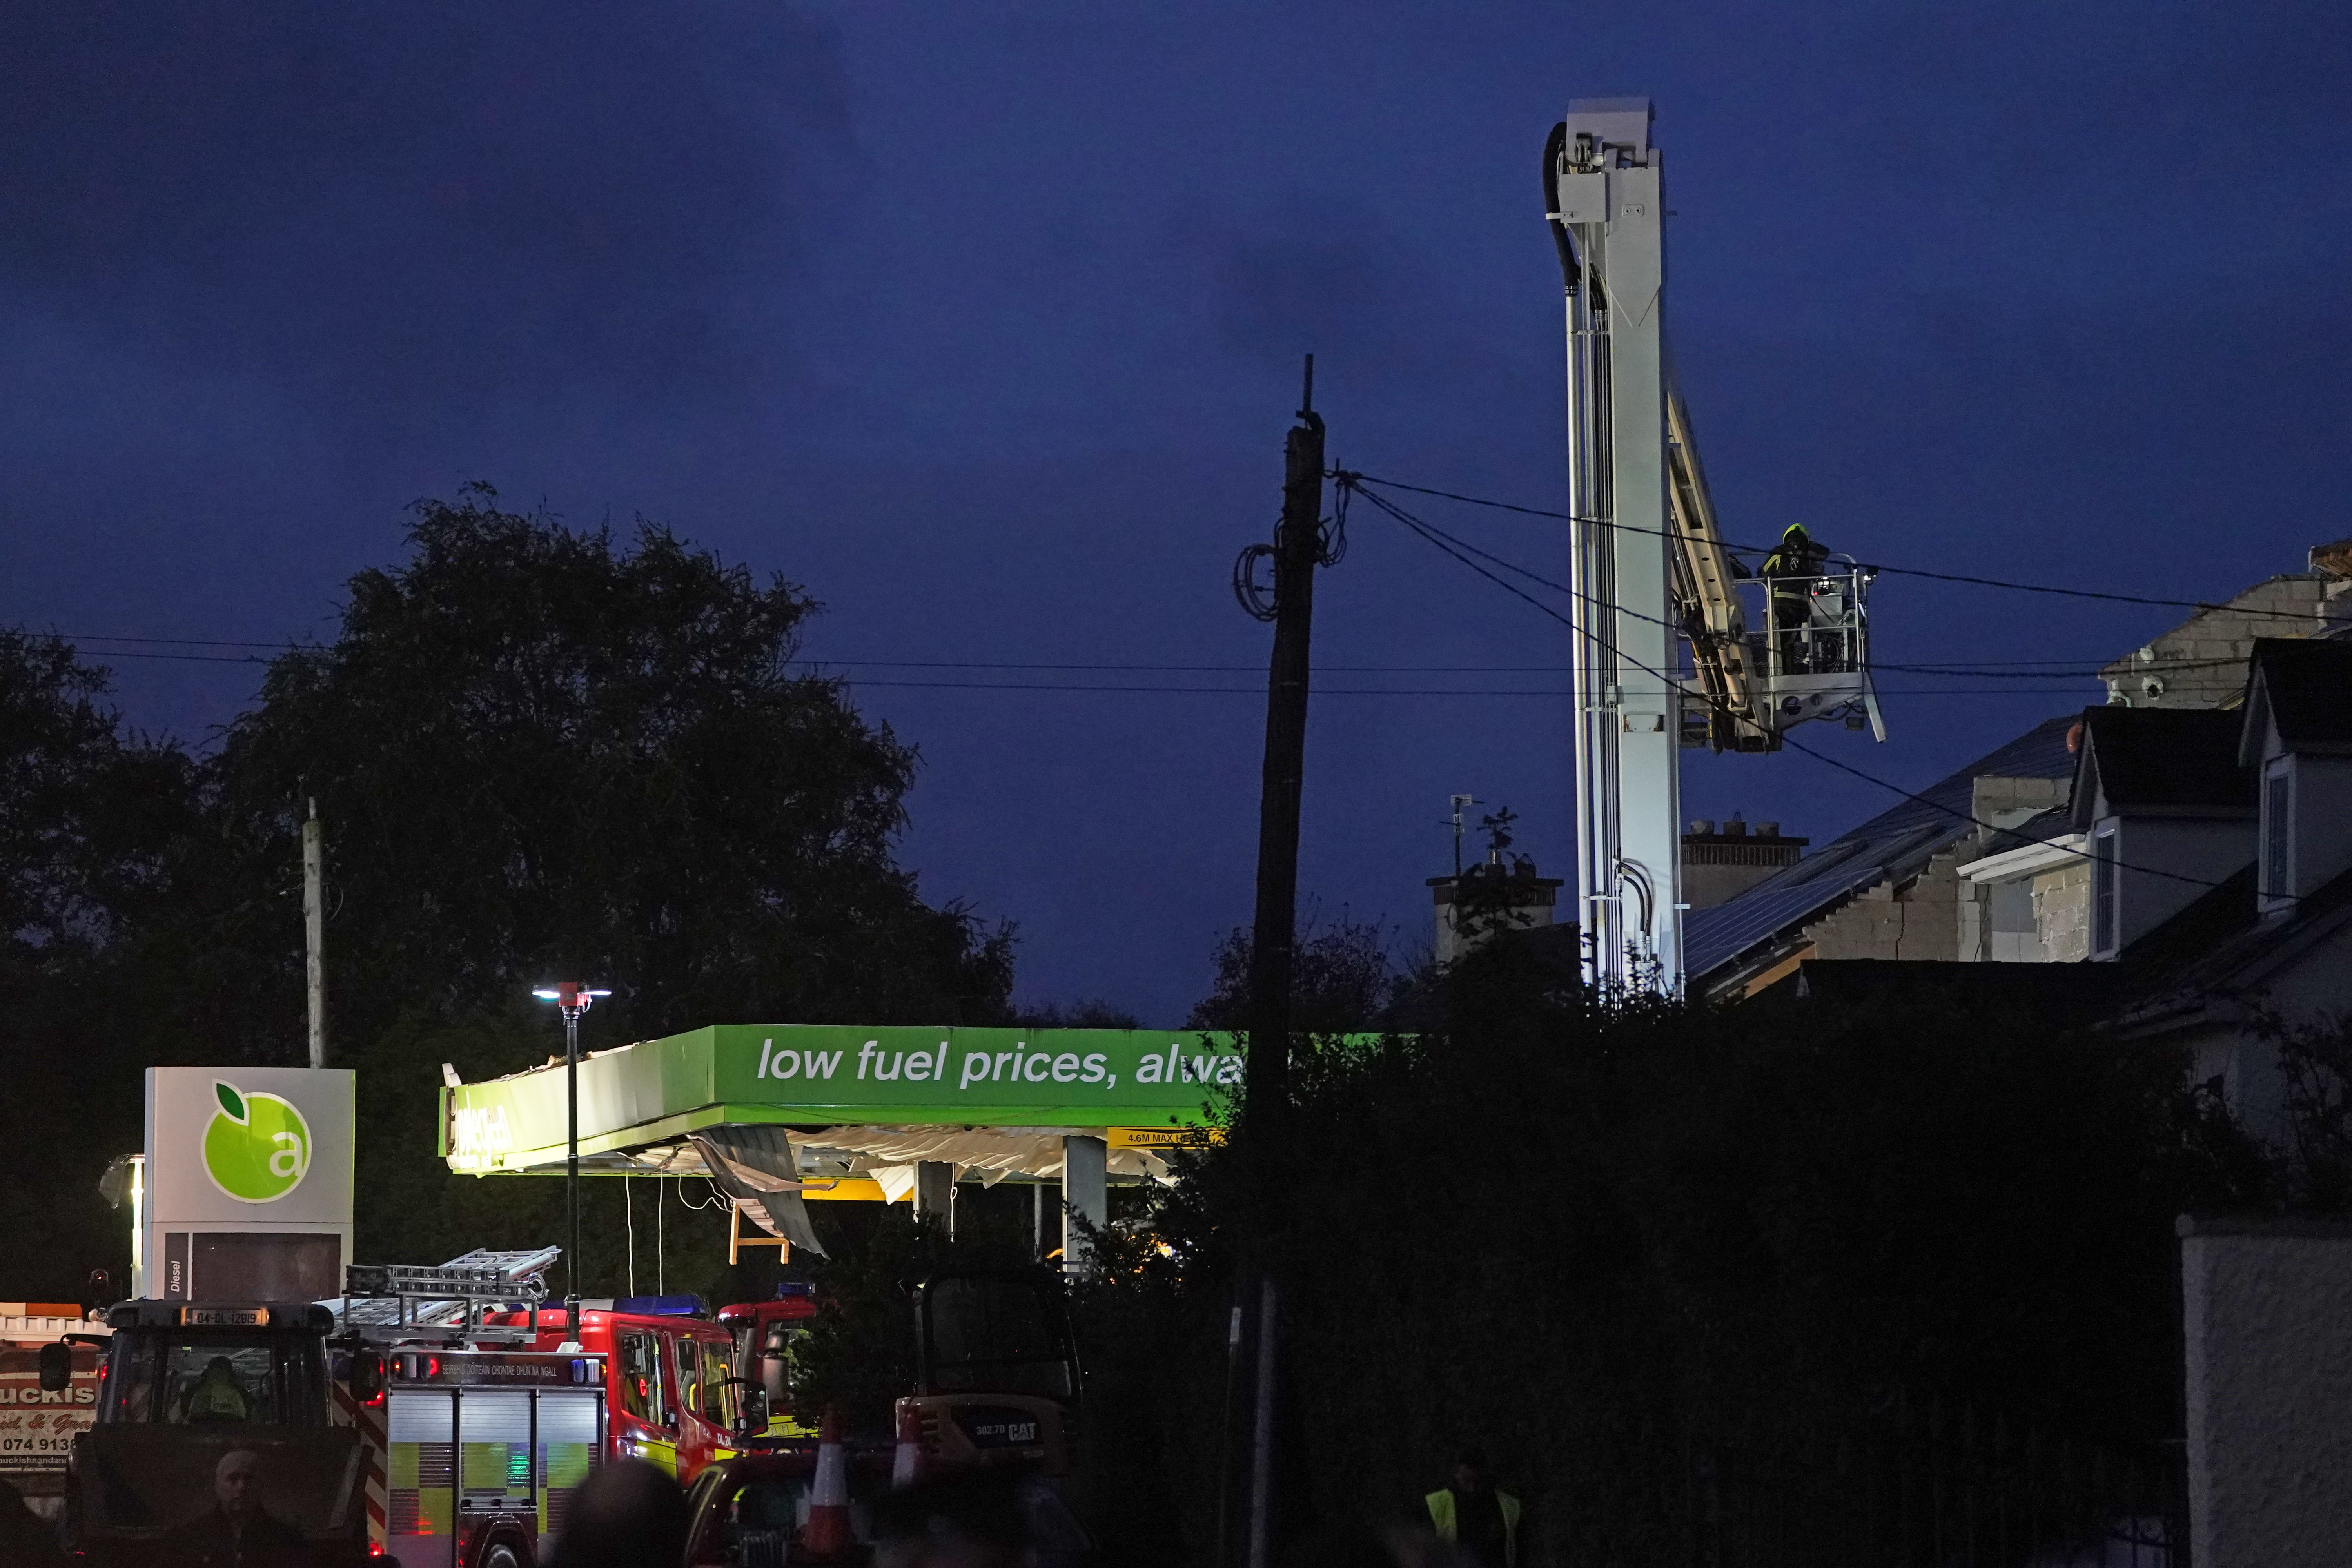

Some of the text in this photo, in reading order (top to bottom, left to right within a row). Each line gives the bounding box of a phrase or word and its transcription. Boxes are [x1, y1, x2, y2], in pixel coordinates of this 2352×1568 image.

[757, 1038, 1245, 1090] low fuel prices, alwa
[1152, 1134, 1173, 1142] MAX
[269, 1131, 303, 1177] a
[170, 1260, 180, 1292] Diesel
[492, 1365, 515, 1375] CHONTAE
[517, 1363, 530, 1376] DHÚN
[532, 1366, 539, 1376] NA
[541, 1366, 557, 1376] NGALL
[1008, 1422, 1036, 1441] CAT
[3, 1439, 34, 1451] 074
